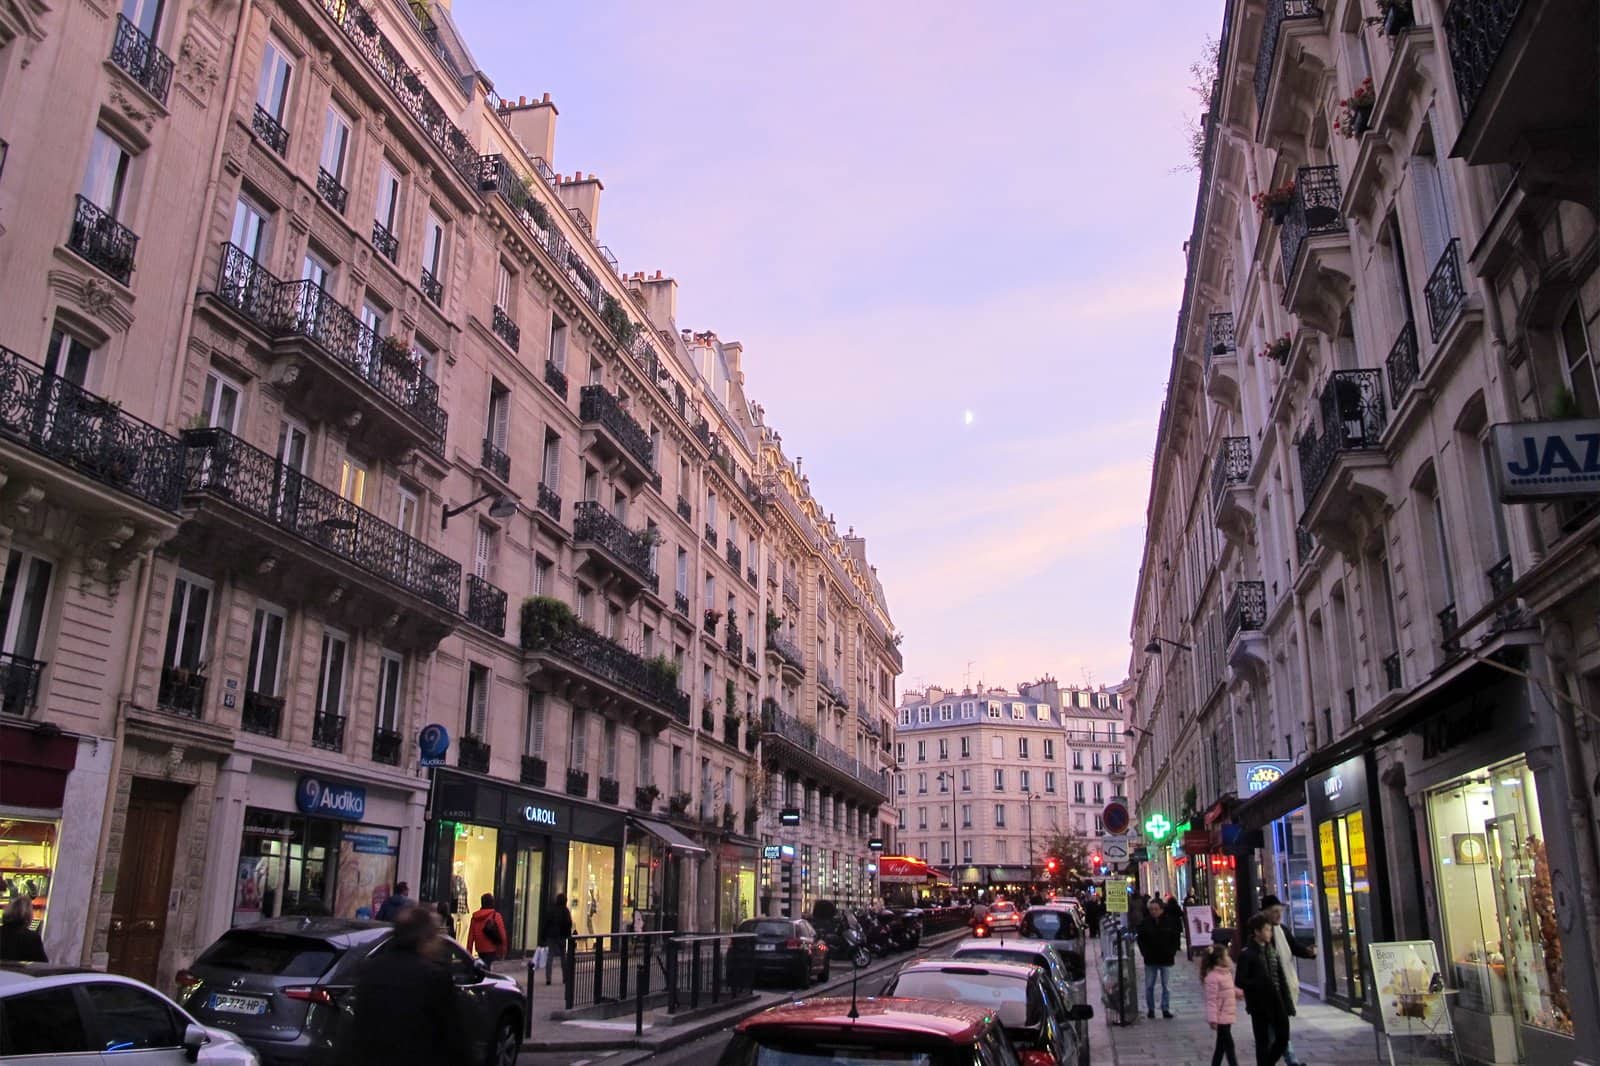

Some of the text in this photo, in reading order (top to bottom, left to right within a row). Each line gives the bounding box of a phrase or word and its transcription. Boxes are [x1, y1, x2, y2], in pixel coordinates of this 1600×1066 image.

[1507, 433, 1600, 476] JAZ
[422, 758, 445, 766] Audika
[320, 786, 363, 813] Audika
[525, 806, 556, 825] CAROLL
